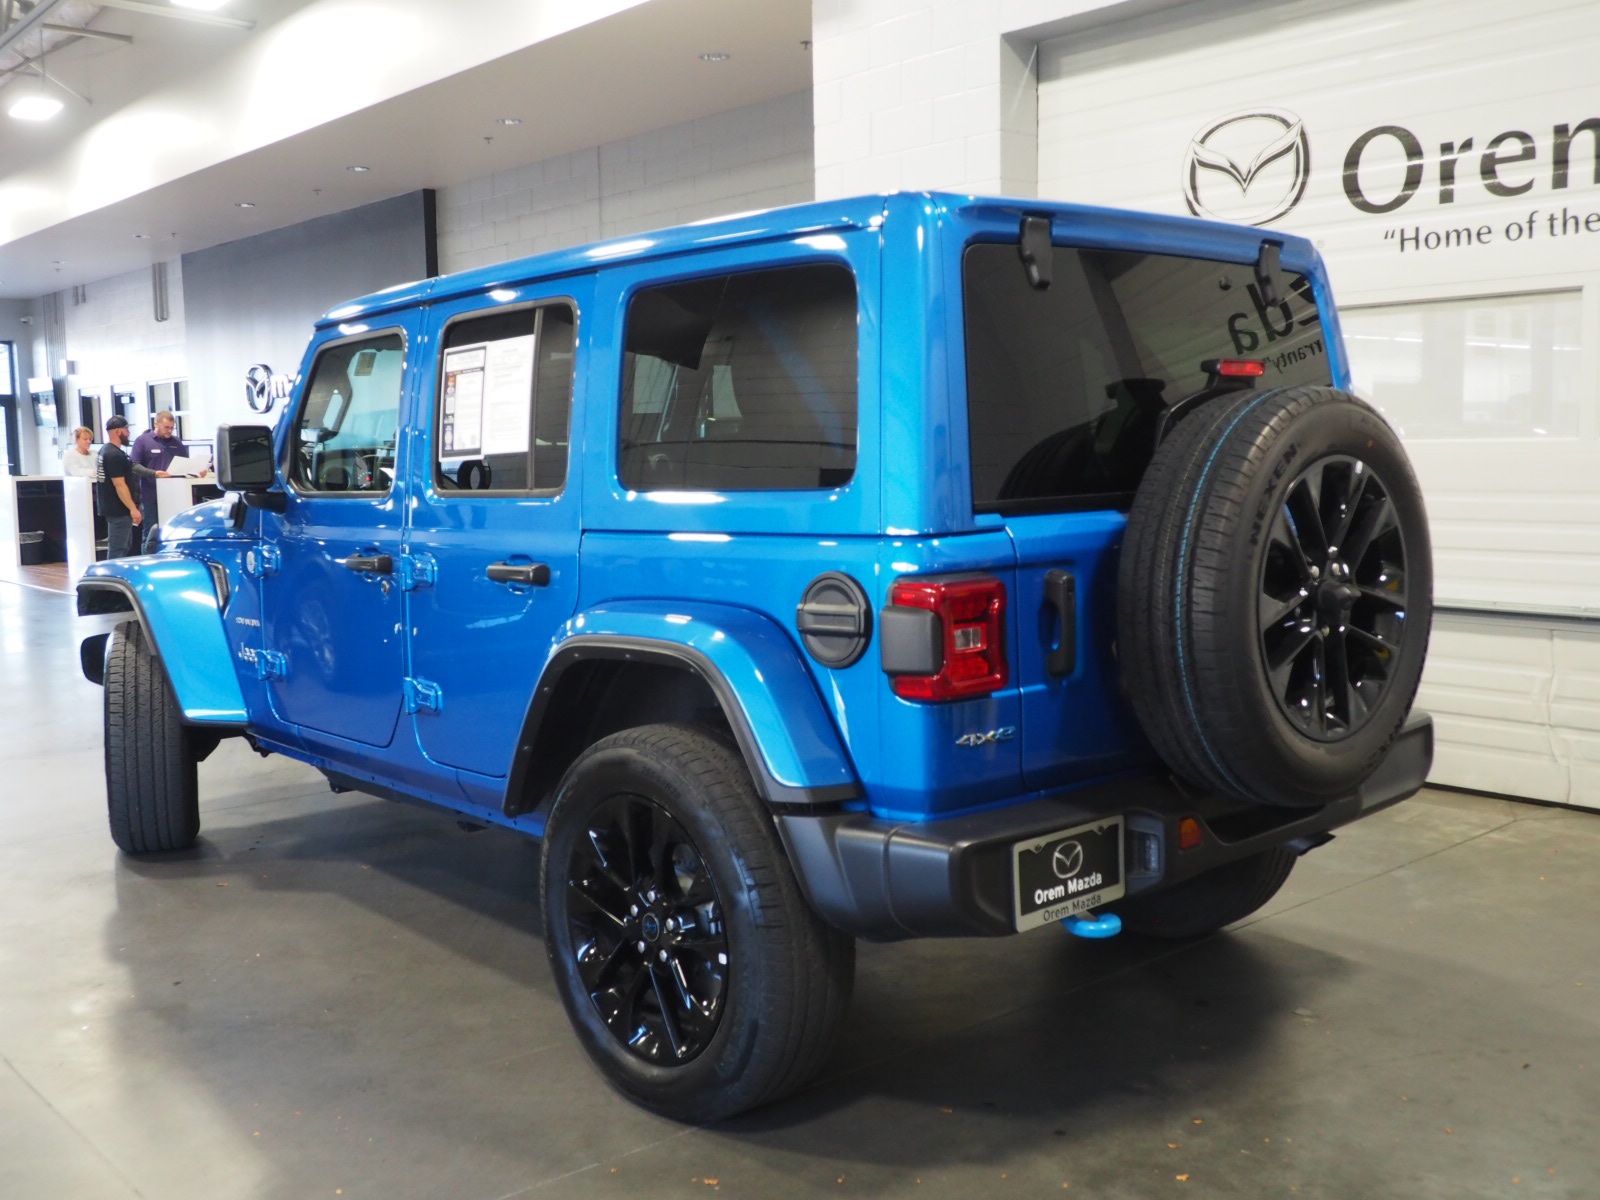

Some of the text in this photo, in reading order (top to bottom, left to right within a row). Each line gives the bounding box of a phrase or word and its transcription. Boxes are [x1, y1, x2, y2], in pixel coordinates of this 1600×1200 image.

[1505, 210, 1539, 242] of
[1547, 207, 1600, 237] the
[1249, 443, 1298, 547] NEXEN
[238, 641, 258, 669] Jee
[1034, 872, 1102, 905] Orem Mazda
[1043, 894, 1102, 922] Orem Mazda
